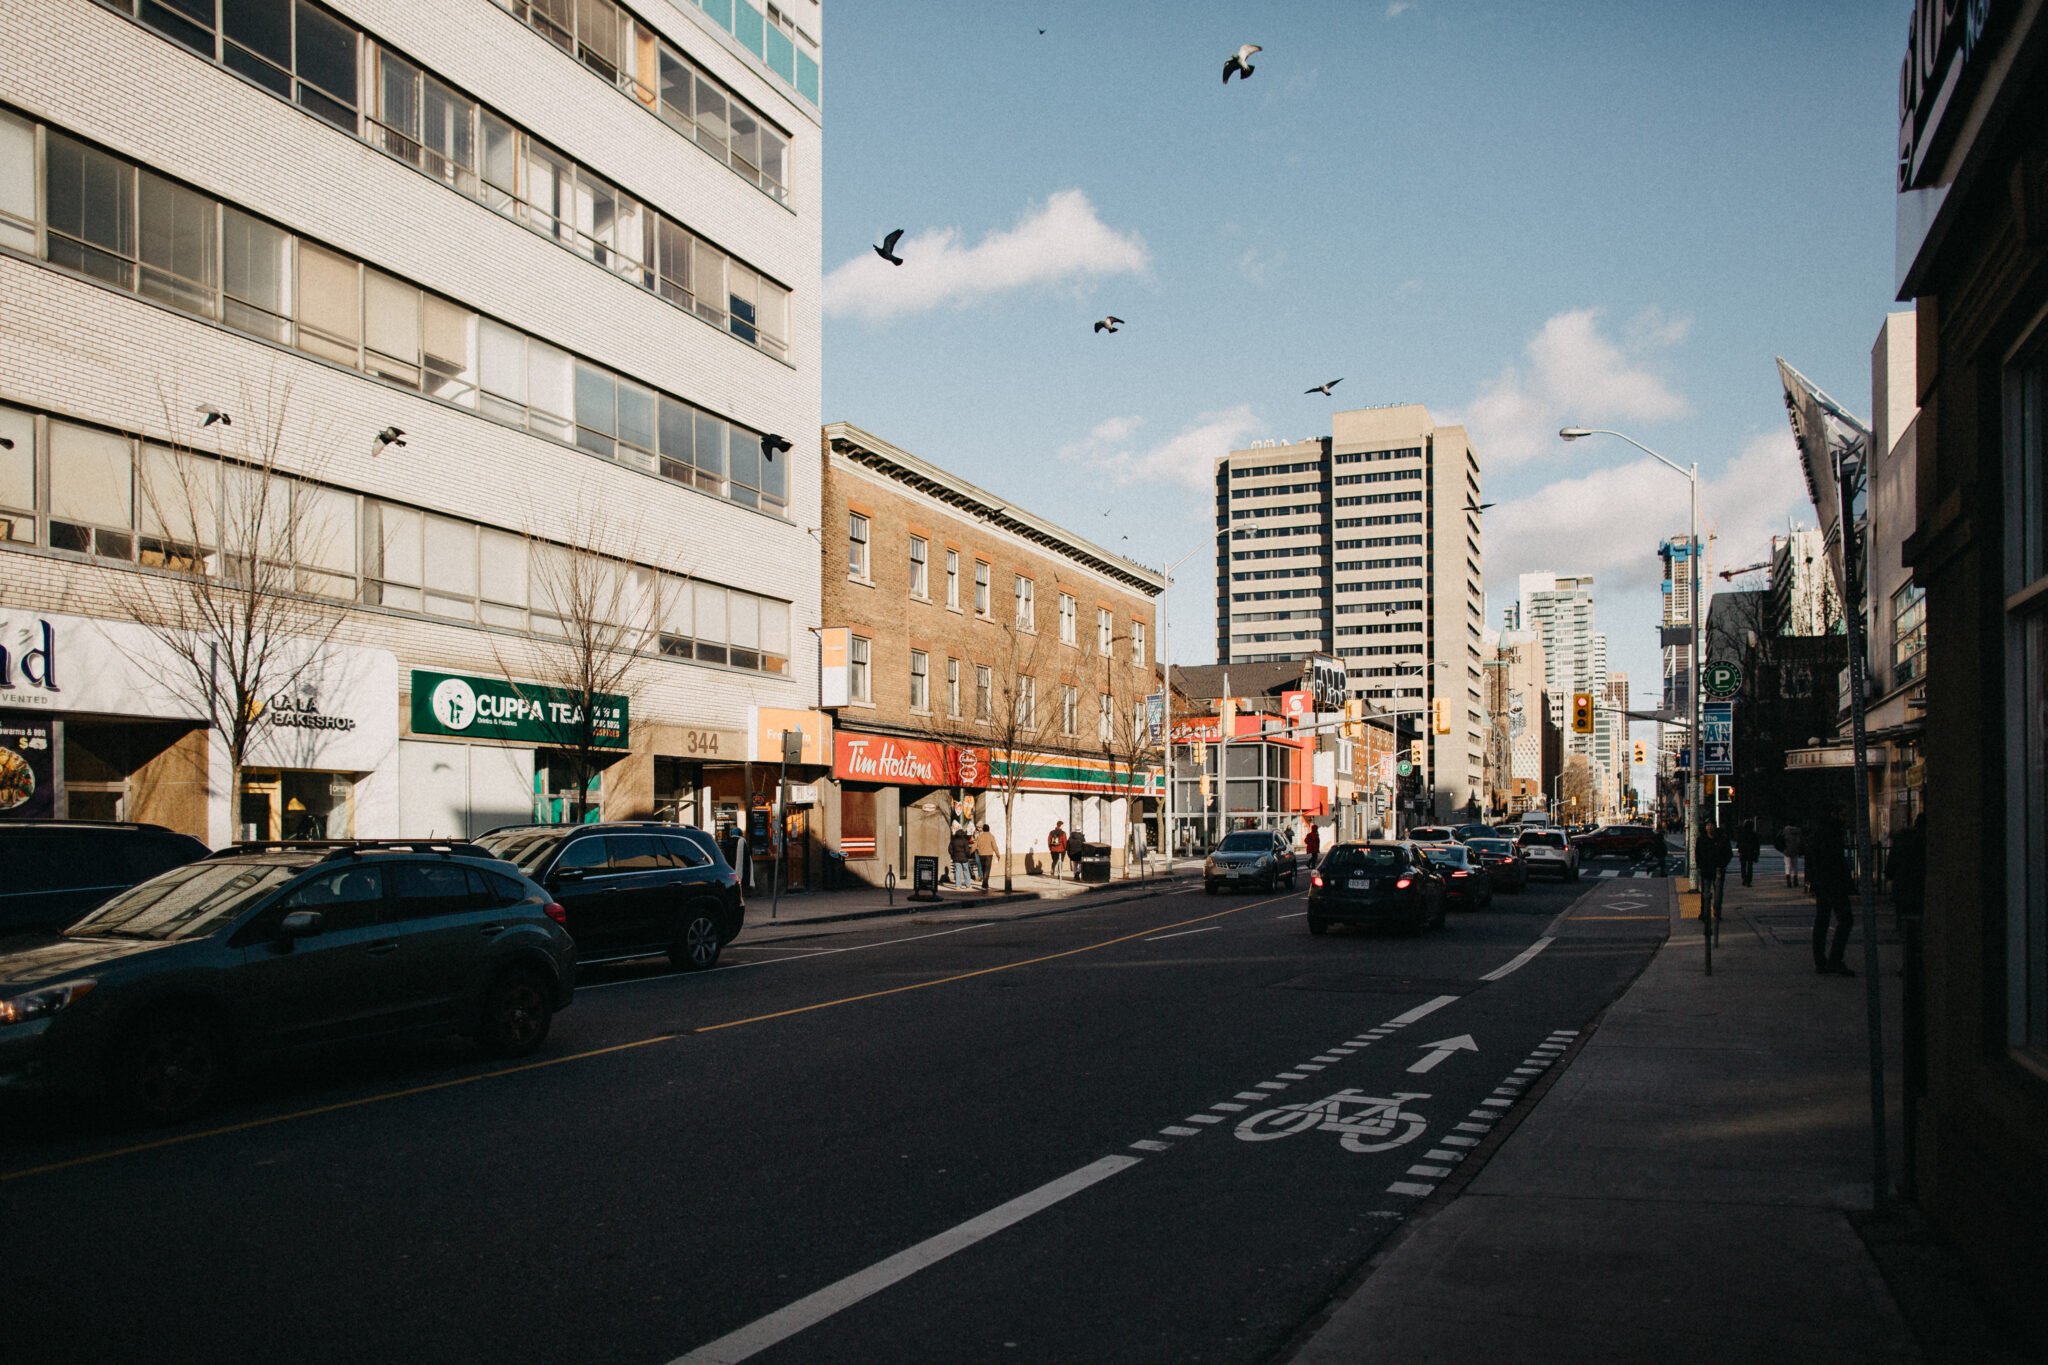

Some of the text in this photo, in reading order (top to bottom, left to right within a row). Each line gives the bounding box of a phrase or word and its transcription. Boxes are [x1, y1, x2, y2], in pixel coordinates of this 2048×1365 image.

[1715, 670, 1730, 685] P
[271, 695, 320, 714] LA LA
[477, 694, 584, 725] CUPPA TEA
[271, 712, 356, 732] BAKESHOP
[687, 730, 719, 754] 344
[767, 728, 812, 741] Frem
[848, 740, 876, 775] Tim
[879, 742, 932, 780] Hortons
